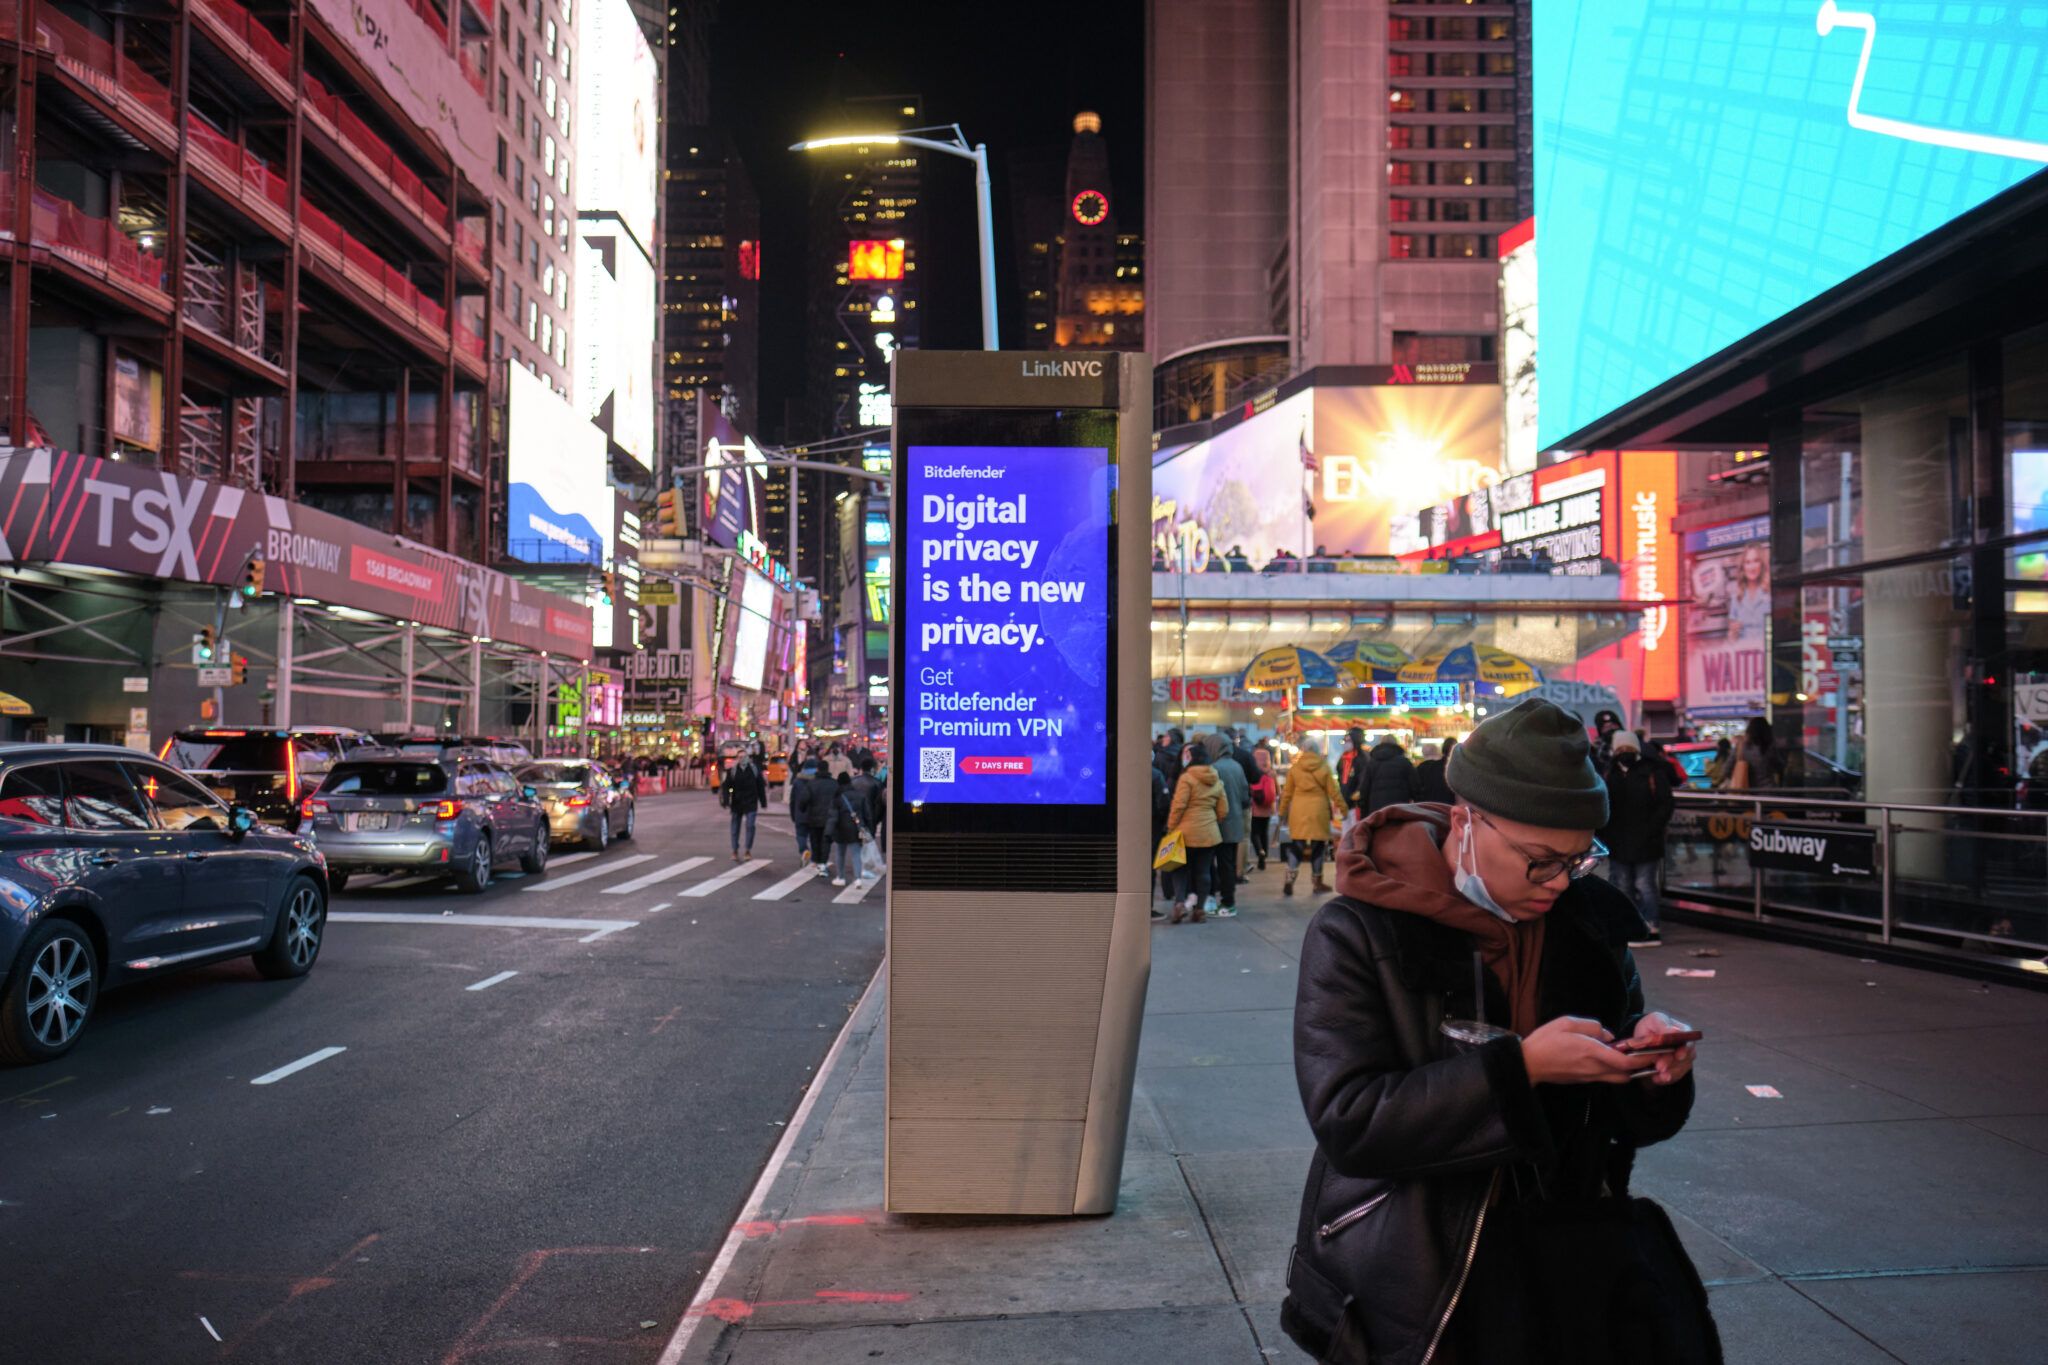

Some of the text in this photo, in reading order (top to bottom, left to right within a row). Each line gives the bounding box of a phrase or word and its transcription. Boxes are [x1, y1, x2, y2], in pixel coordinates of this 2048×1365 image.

[1022, 360, 1102, 376] LinkNYC
[1416, 363, 1471, 373] MARRIOTT
[1416, 373, 1465, 382] MARQUIS
[924, 466, 1005, 478] Bitdefender
[922, 494, 1026, 530] Digital
[1501, 491, 1601, 543] VALERIE JUNE
[84, 472, 341, 581] TSX BROADWAY
[1707, 528, 1754, 547] JENNIFER
[922, 532, 1039, 569] privacy
[387, 565, 433, 591] BROADWAY
[923, 573, 1085, 602] is the new
[457, 568, 490, 638] TSX
[922, 616, 1044, 652] privacy.
[920, 667, 953, 685] Get
[920, 692, 1036, 711] Bitdefender
[920, 718, 1062, 736] Premium VPN
[1751, 828, 1826, 862] Subway
